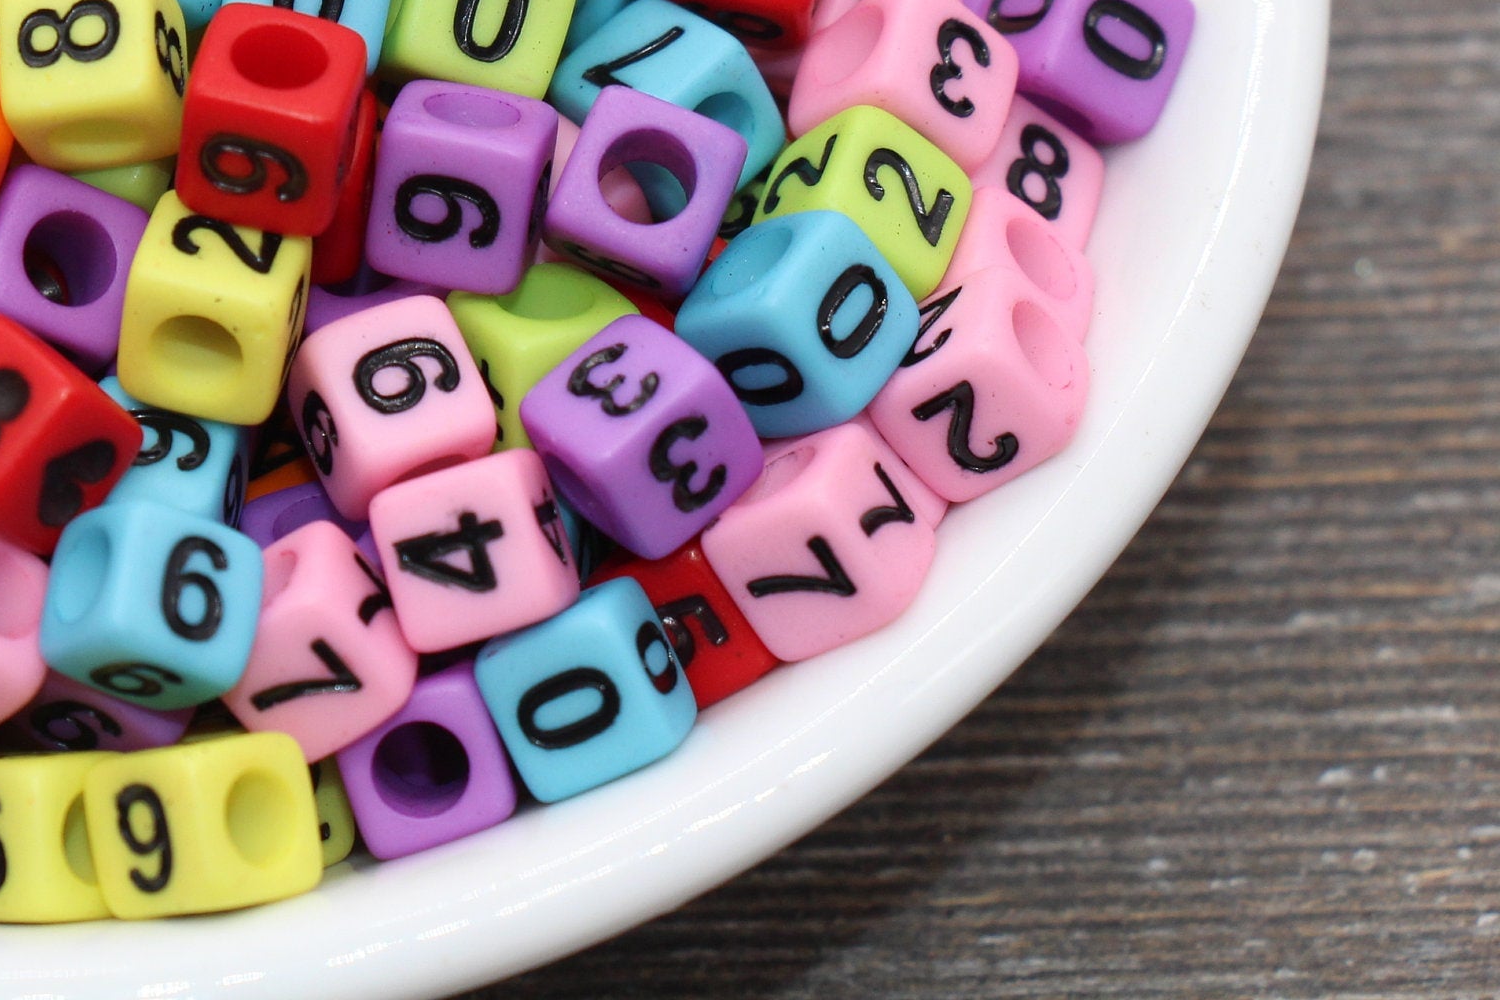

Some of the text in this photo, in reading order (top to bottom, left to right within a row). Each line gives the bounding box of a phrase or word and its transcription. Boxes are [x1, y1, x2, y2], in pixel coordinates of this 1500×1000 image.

[581, 25, 685, 87] 7
[929, 17, 991, 119] 3
[863, 147, 955, 248] 2
[1006, 122, 1070, 221] 8
[171, 213, 284, 275] 2
[816, 263, 889, 360] 0
[566, 342, 660, 418] 3
[714, 347, 805, 407] 0
[649, 414, 727, 514] 3
[911, 379, 1020, 474] 2
[859, 461, 916, 537] 7
[161, 535, 228, 641] 6
[392, 510, 505, 594] 4
[746, 535, 858, 598] 7
[251, 638, 364, 712] 7
[517, 666, 621, 750] 0
[116, 783, 172, 895] 9
